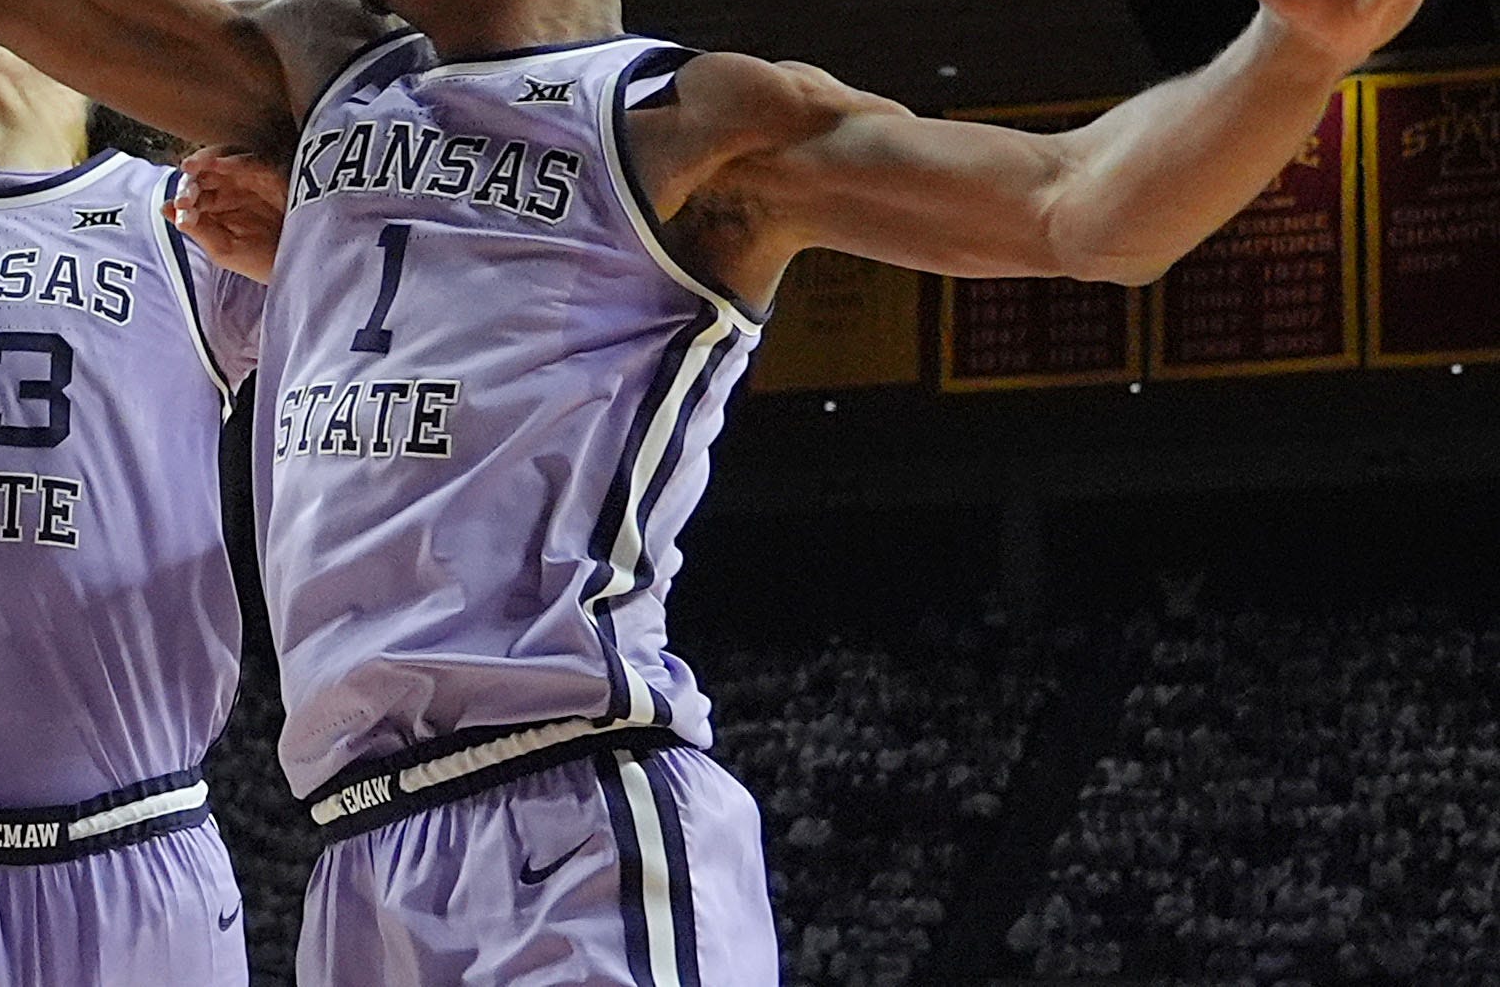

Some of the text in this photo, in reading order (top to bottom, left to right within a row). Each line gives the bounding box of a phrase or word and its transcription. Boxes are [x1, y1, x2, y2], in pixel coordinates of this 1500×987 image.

[286, 120, 581, 225] KANSAS
[349, 223, 411, 355] 1
[274, 378, 463, 464] STATE
[341, 774, 393, 815] EMAW
